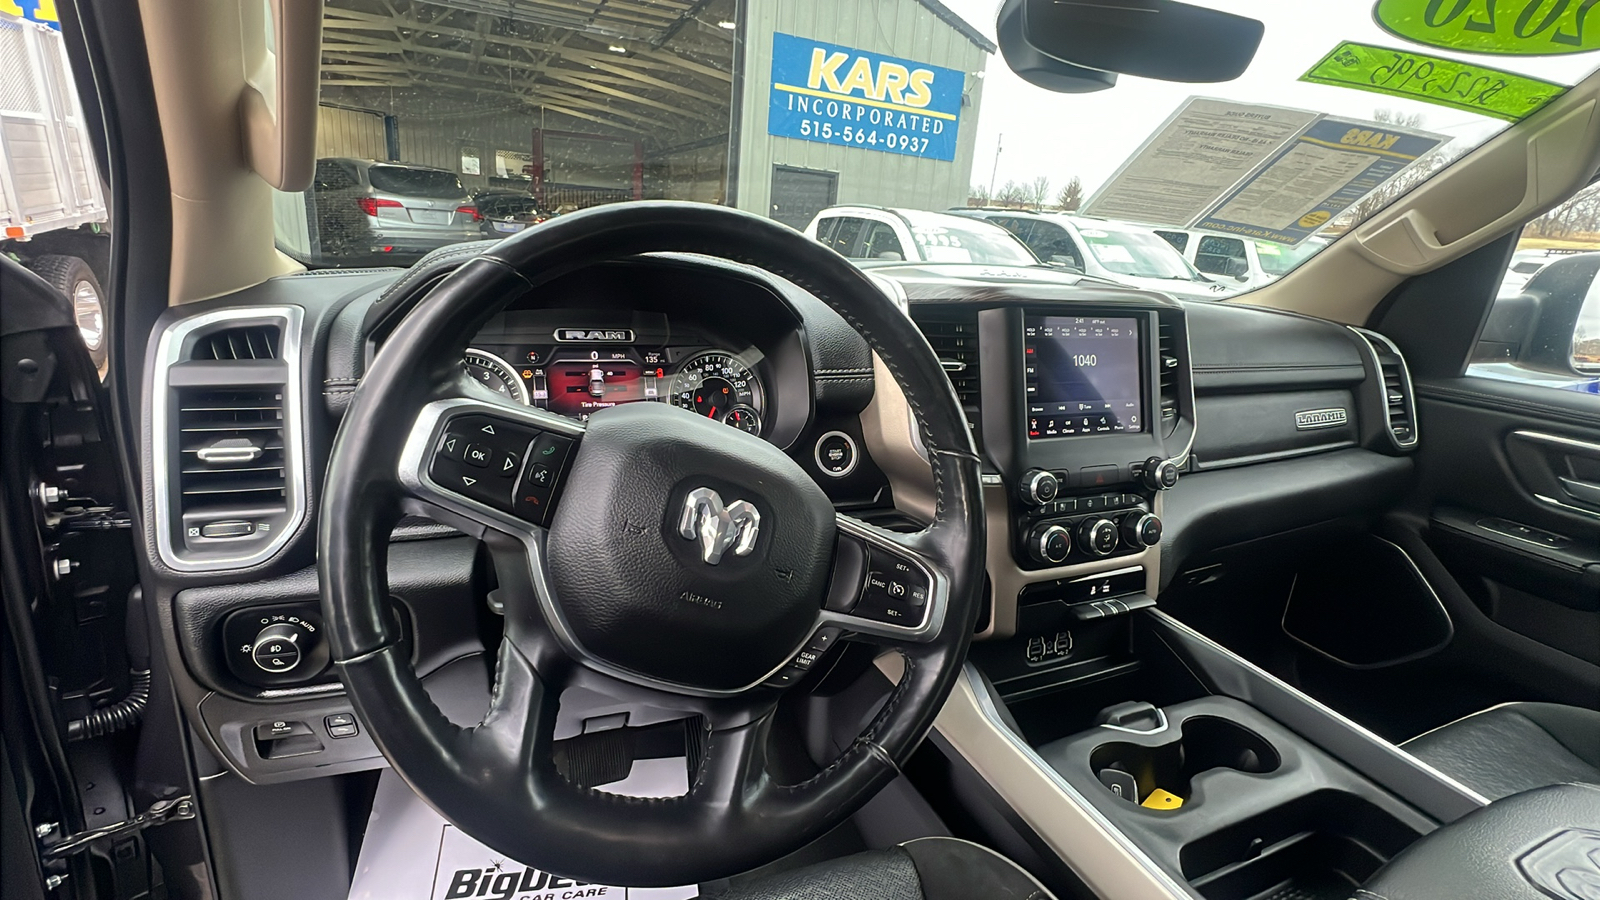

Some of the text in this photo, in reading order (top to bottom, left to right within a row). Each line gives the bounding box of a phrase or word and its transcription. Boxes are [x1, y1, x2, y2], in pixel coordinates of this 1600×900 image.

[807, 47, 935, 108] KARS
[788, 94, 944, 135] INCORPORATED
[800, 119, 930, 154] 515-564-0937
[565, 330, 626, 340] RAM
[1073, 354, 1097, 367] 1040
[483, 372, 490, 380] 3
[498, 384, 506, 393] 4
[471, 450, 486, 461] OK
[896, 563, 910, 572] SET+
[871, 578, 886, 588] CANC
[912, 592, 924, 600] RES
[300, 620, 316, 633] AUTO
[796, 657, 812, 666] LIMIT
[801, 652, 817, 661] GEAR
[561, 887, 608, 900] CARE
